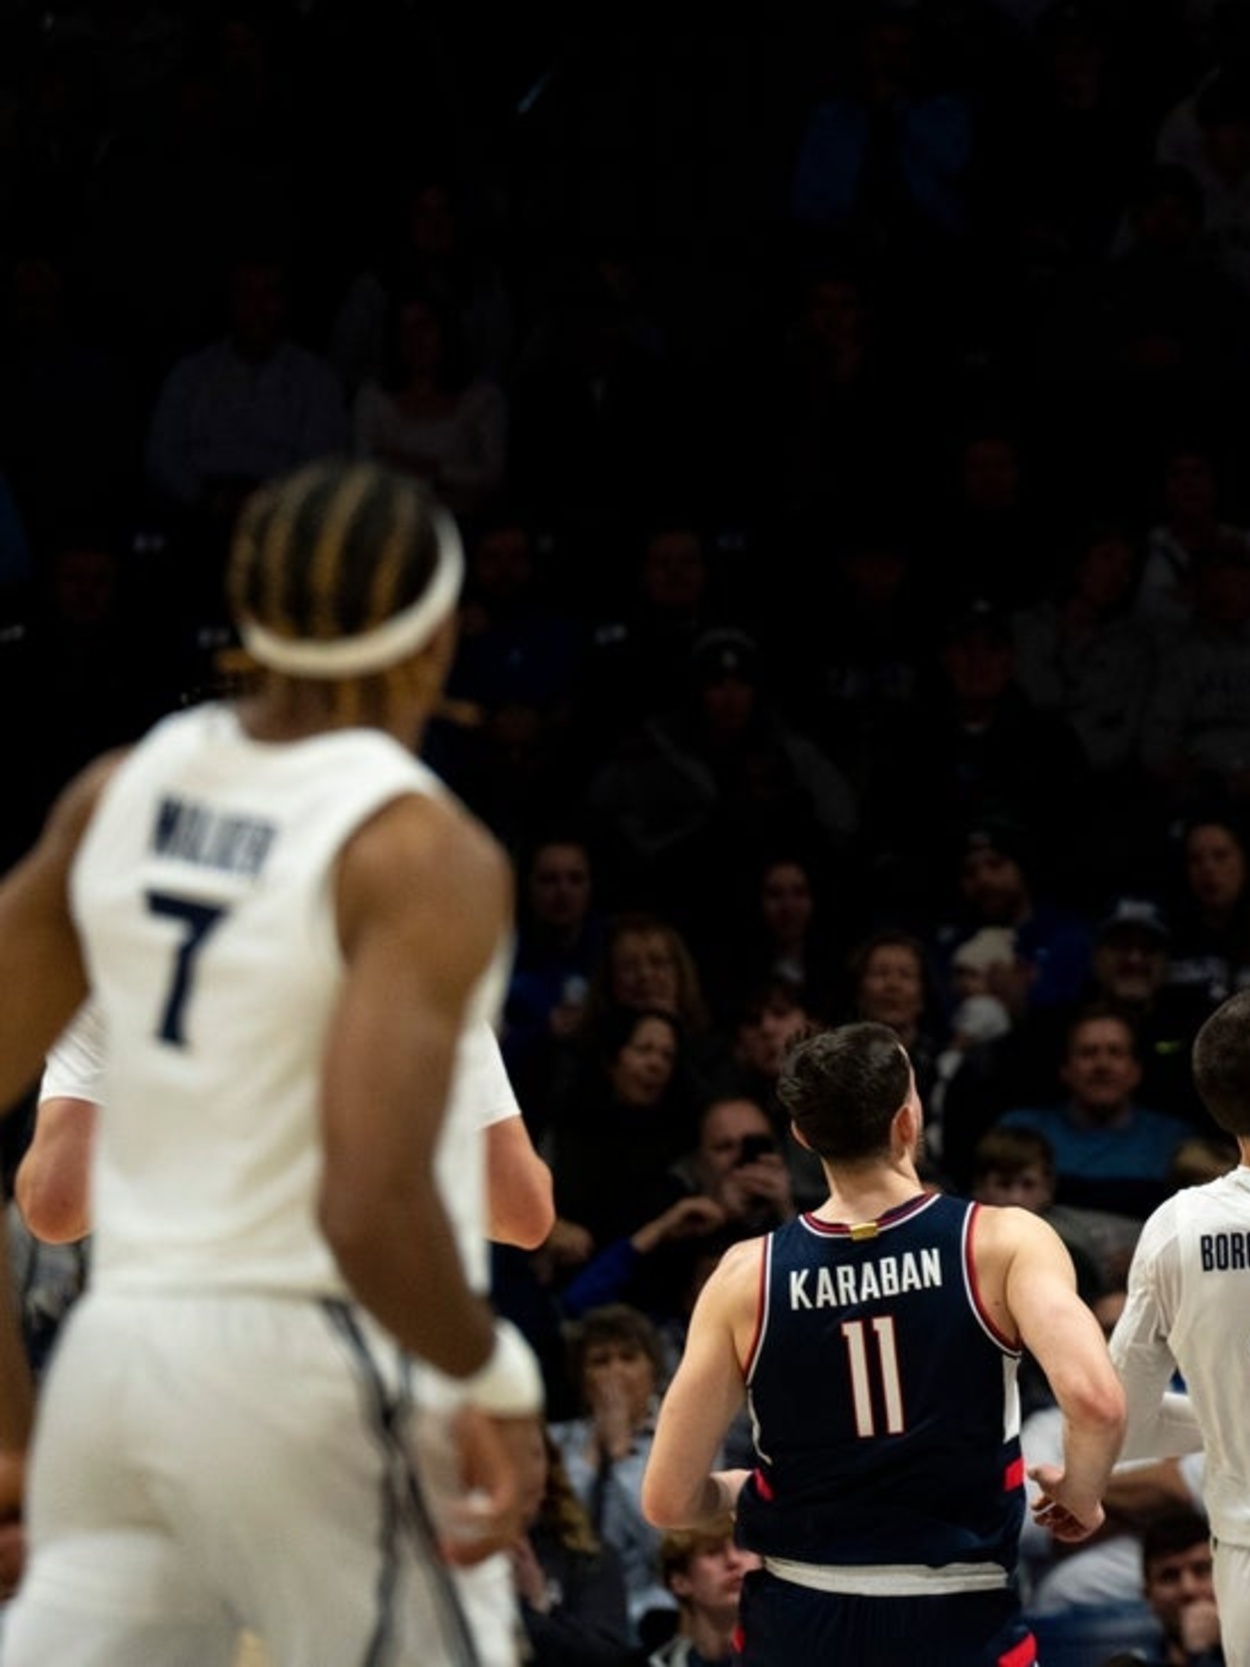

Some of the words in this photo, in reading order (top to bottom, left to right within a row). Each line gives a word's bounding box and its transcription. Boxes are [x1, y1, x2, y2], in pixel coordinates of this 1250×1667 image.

[145, 888, 231, 1048] 7
[789, 1248, 943, 1311] KARABAN
[841, 1315, 905, 1438] 11
